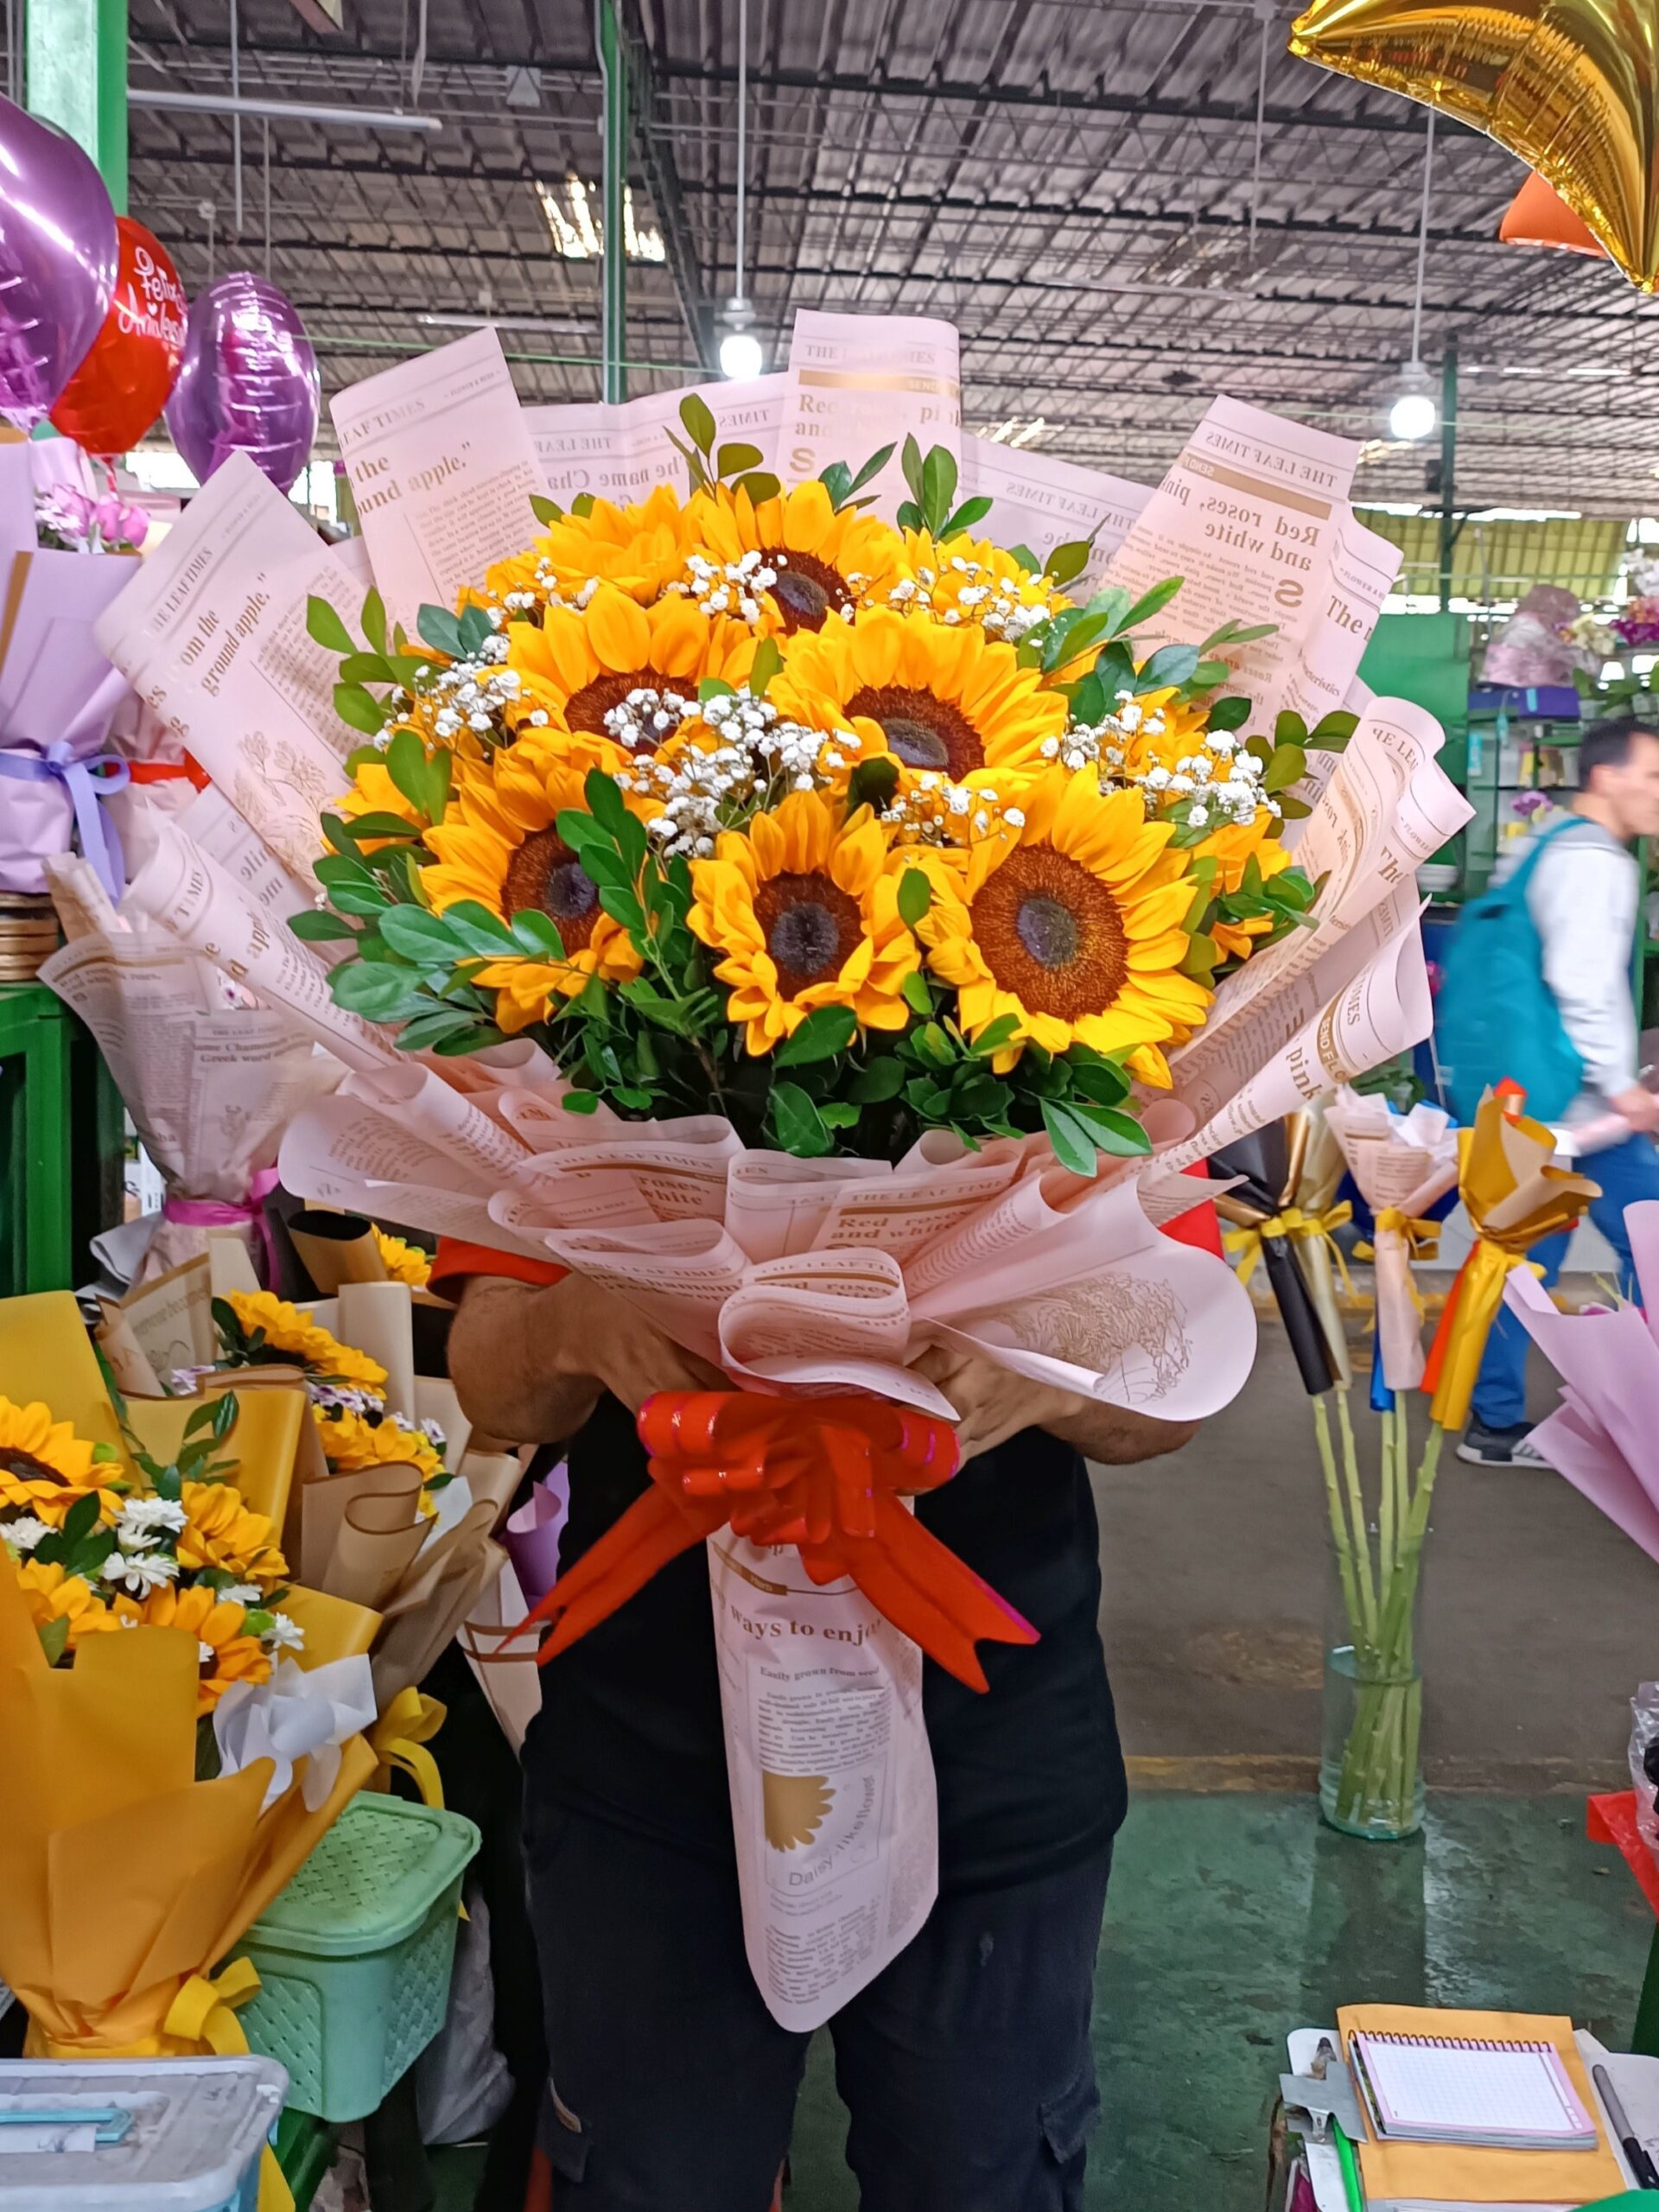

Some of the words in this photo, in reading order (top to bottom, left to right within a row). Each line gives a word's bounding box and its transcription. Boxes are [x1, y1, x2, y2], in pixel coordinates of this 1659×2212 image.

[805, 345, 837, 359] THE
[373, 400, 425, 429] TIMES
[355, 456, 390, 483] the
[184, 546, 213, 584] TIMES
[197, 609, 220, 639] the
[1325, 594, 1363, 634] The
[1285, 1046, 1323, 1101] pink
[639, 1176, 711, 1195] roses,
[830, 1229, 880, 1239] and
[837, 1217, 890, 1229] Red
[730, 1605, 782, 1641] Ways
[789, 1620, 815, 1637] to
[760, 1666, 791, 1682] Easily
[794, 1668, 827, 1681] grown
[830, 1667, 856, 1678] from
